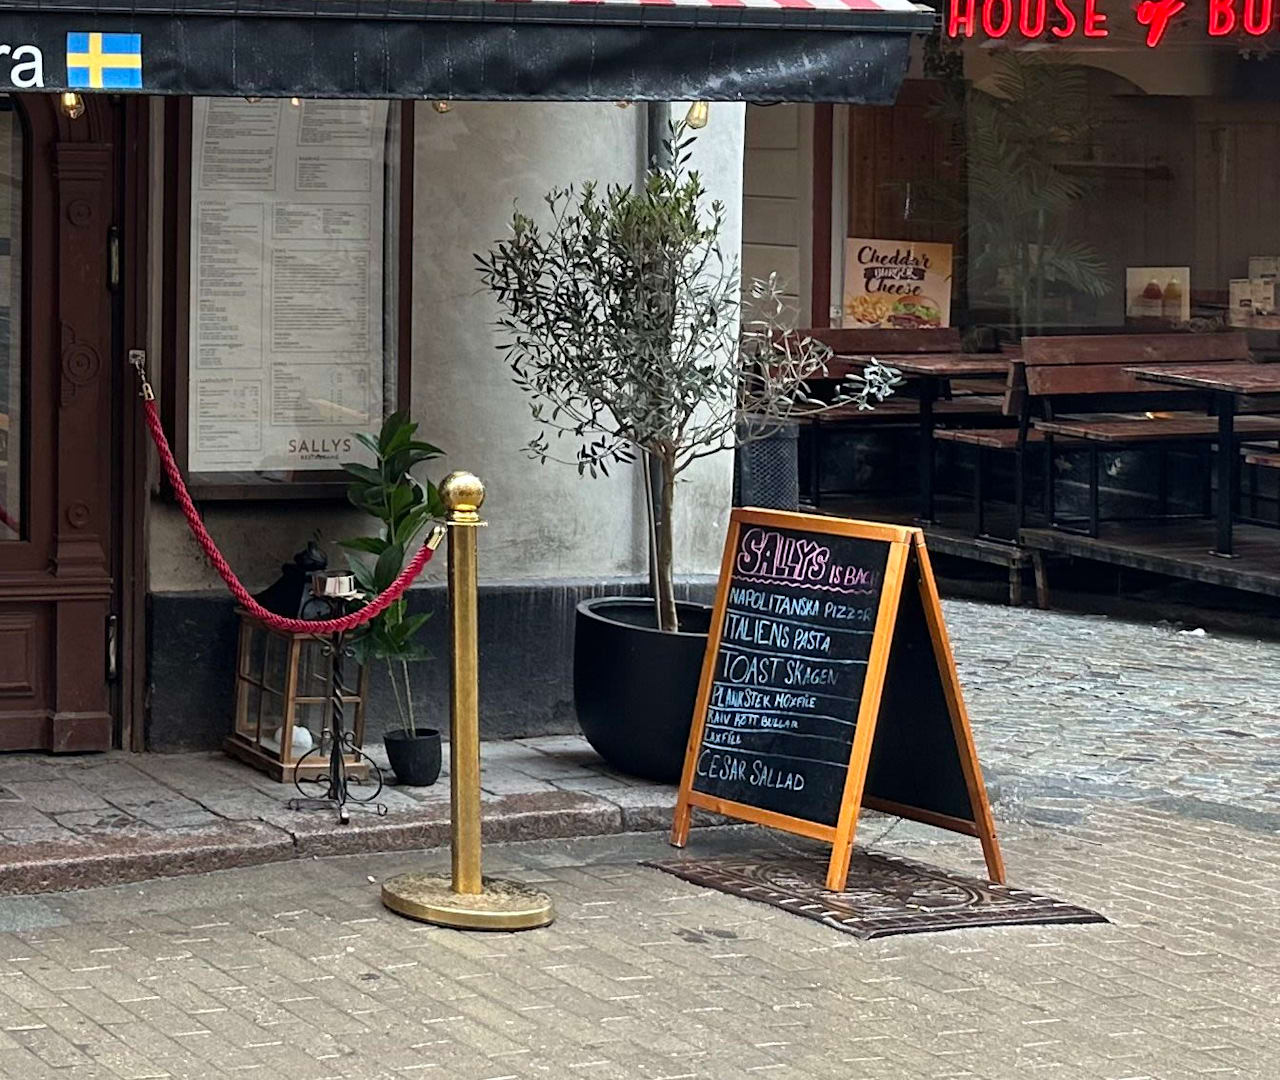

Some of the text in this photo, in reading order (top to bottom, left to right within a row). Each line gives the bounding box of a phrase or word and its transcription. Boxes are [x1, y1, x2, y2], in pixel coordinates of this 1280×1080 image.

[864, 278, 921, 297] Cheese
[288, 438, 351, 453] SALLYS
[737, 527, 830, 581] SALLYS
[828, 564, 843, 584] IS
[729, 586, 820, 617] NAPOLITANSKA
[723, 612, 831, 653] ITALIENS PASTA
[718, 648, 840, 687] TOAST SKAGEN
[696, 748, 805, 791] CESAR SALLAD
